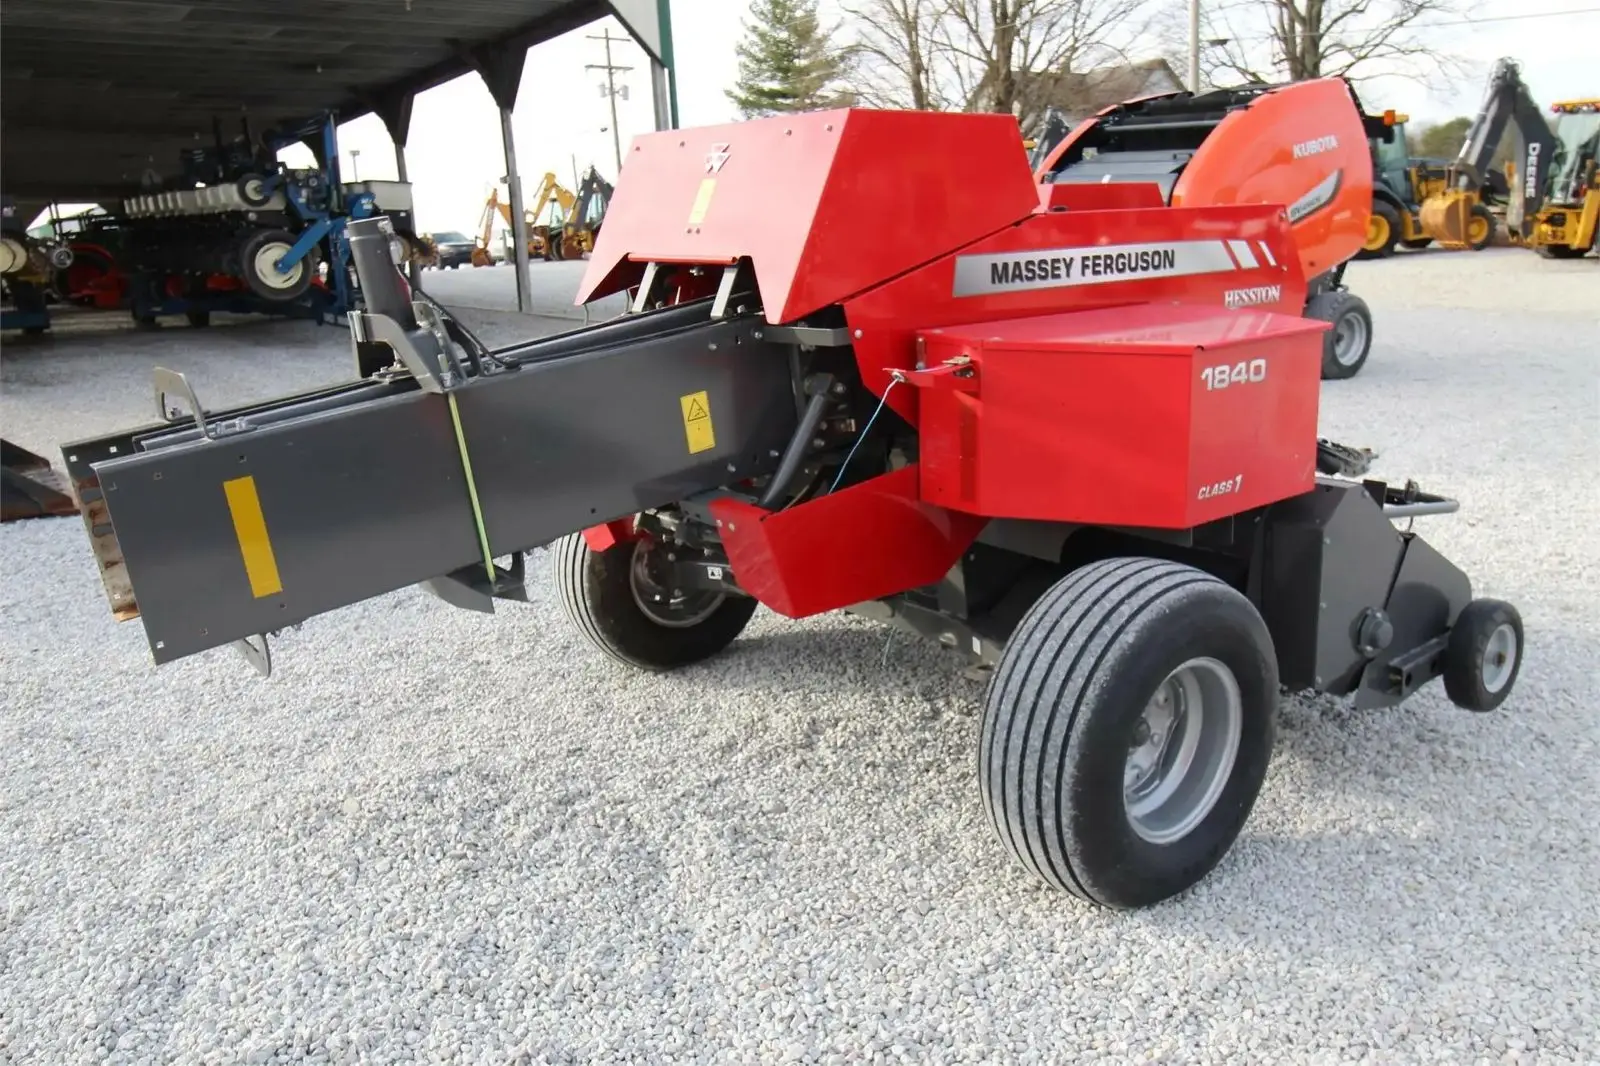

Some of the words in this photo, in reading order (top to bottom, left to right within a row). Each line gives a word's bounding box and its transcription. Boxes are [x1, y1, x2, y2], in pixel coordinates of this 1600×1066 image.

[1293, 134, 1338, 159] KUBOTA
[1525, 142, 1541, 198] DEERE
[991, 257, 1074, 285] MASSEY
[1081, 249, 1175, 277] FERGUSON
[1224, 285, 1281, 309] HESSTON
[1201, 358, 1267, 391] 1840
[1197, 479, 1233, 500] CLASS
